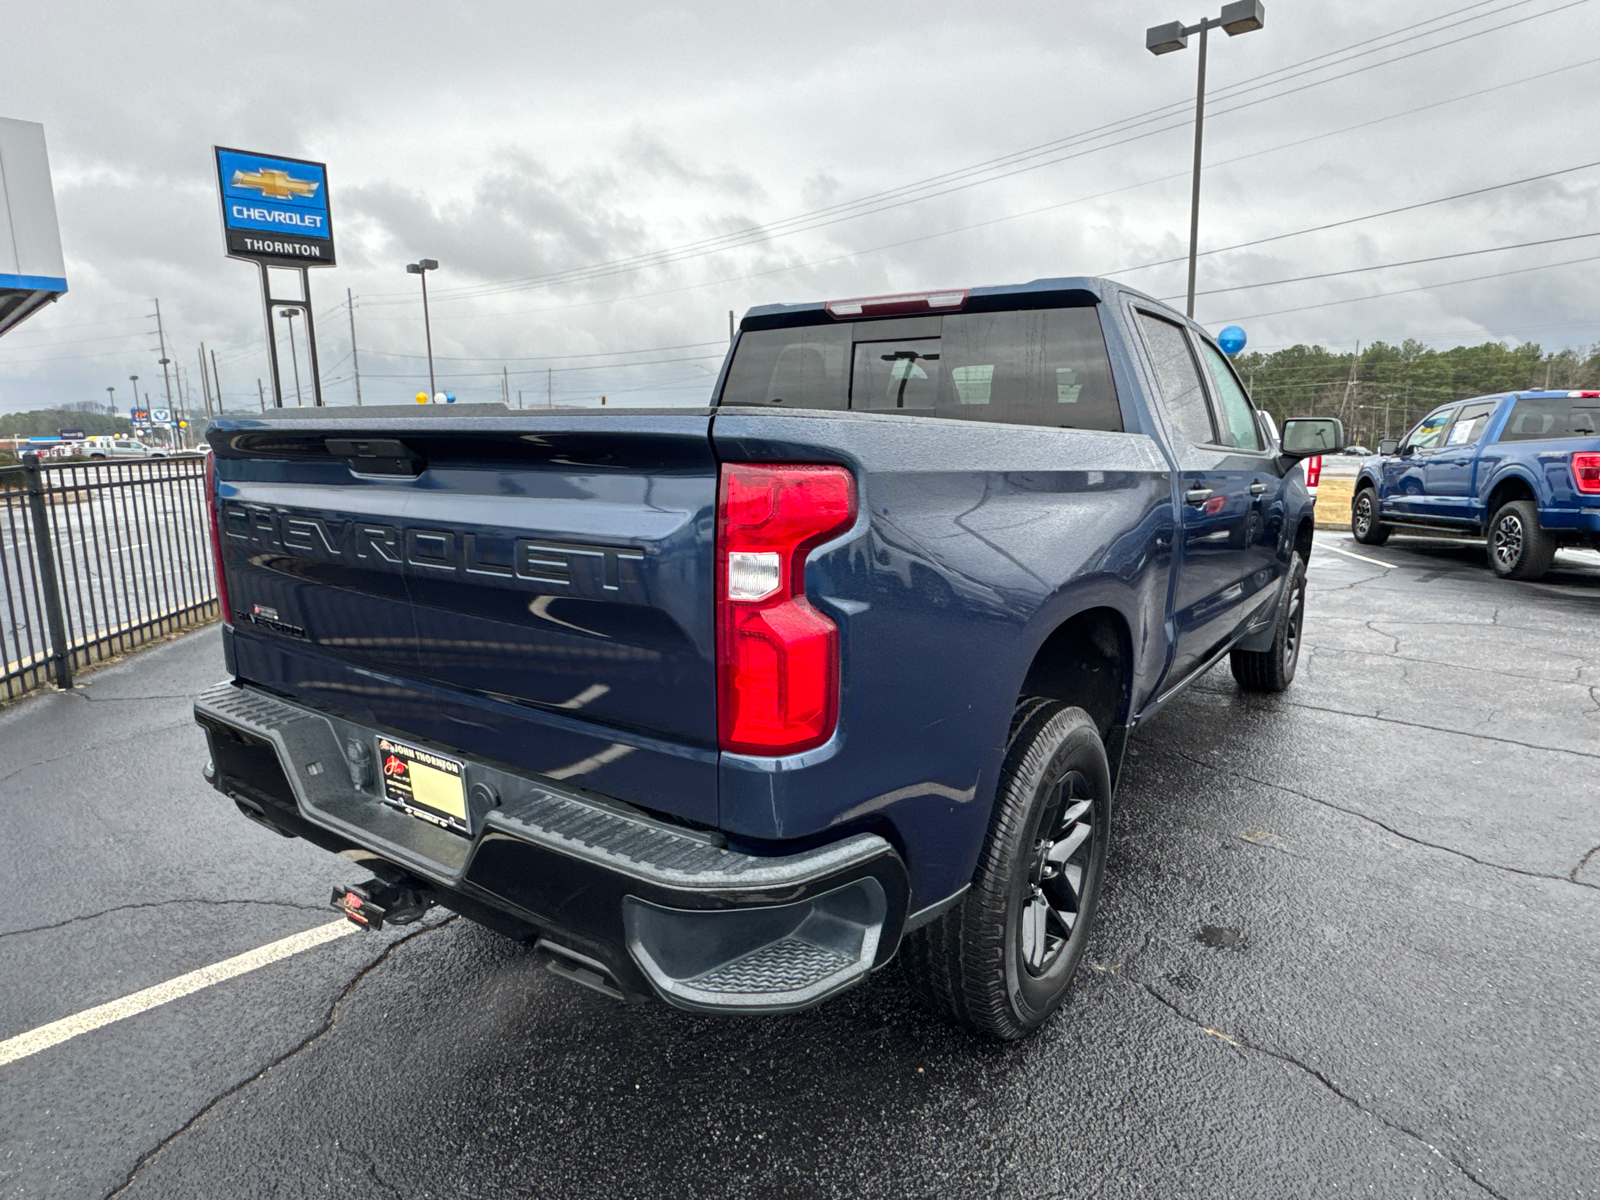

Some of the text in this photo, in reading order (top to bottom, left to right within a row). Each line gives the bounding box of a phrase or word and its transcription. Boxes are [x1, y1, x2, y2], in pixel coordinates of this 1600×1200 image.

[232, 205, 323, 228] CHEVROLET
[244, 238, 320, 257] THORNTON
[222, 507, 646, 590] CHEVROLET
[393, 744, 459, 773] JOHN THORNTON
